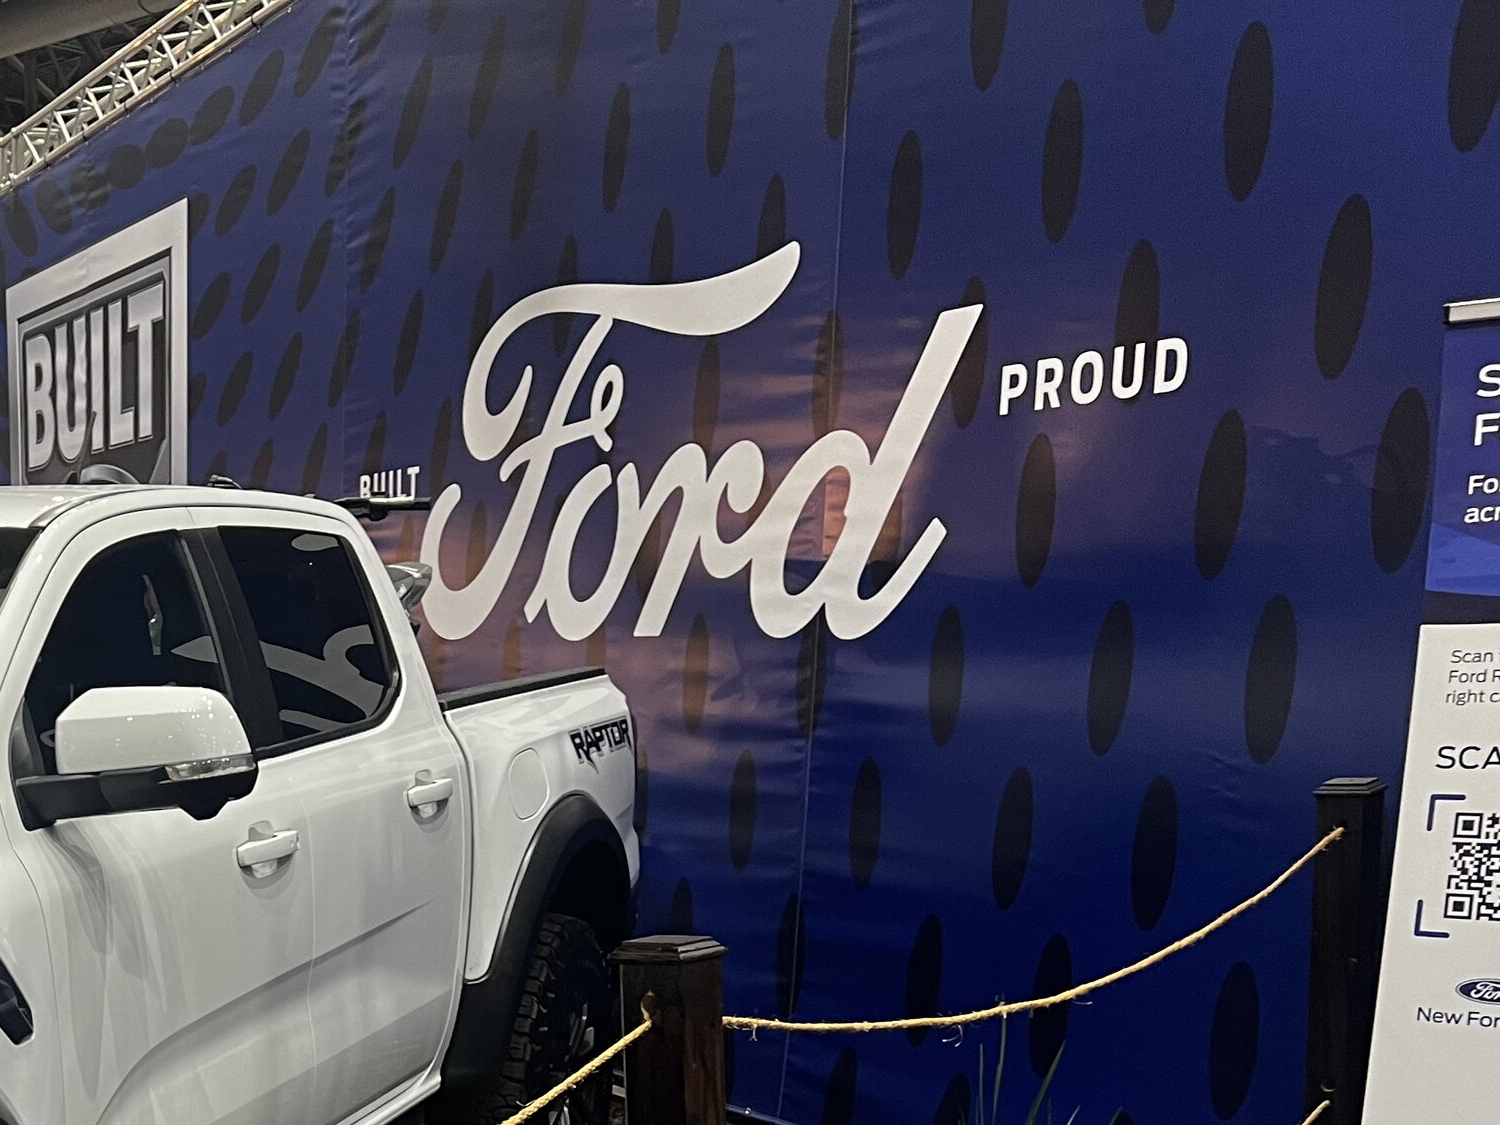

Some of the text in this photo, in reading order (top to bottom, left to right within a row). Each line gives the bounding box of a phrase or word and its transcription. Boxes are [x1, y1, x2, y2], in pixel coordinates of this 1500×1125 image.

[25, 281, 165, 472] BUILT
[359, 240, 1189, 641] BUILT Ford PROUD
[1450, 649, 1494, 664] Scan
[1448, 669, 1488, 683] Ford
[1445, 690, 1485, 706] right
[567, 717, 633, 772] RAPTOR
[1416, 1006, 1464, 1025] New
